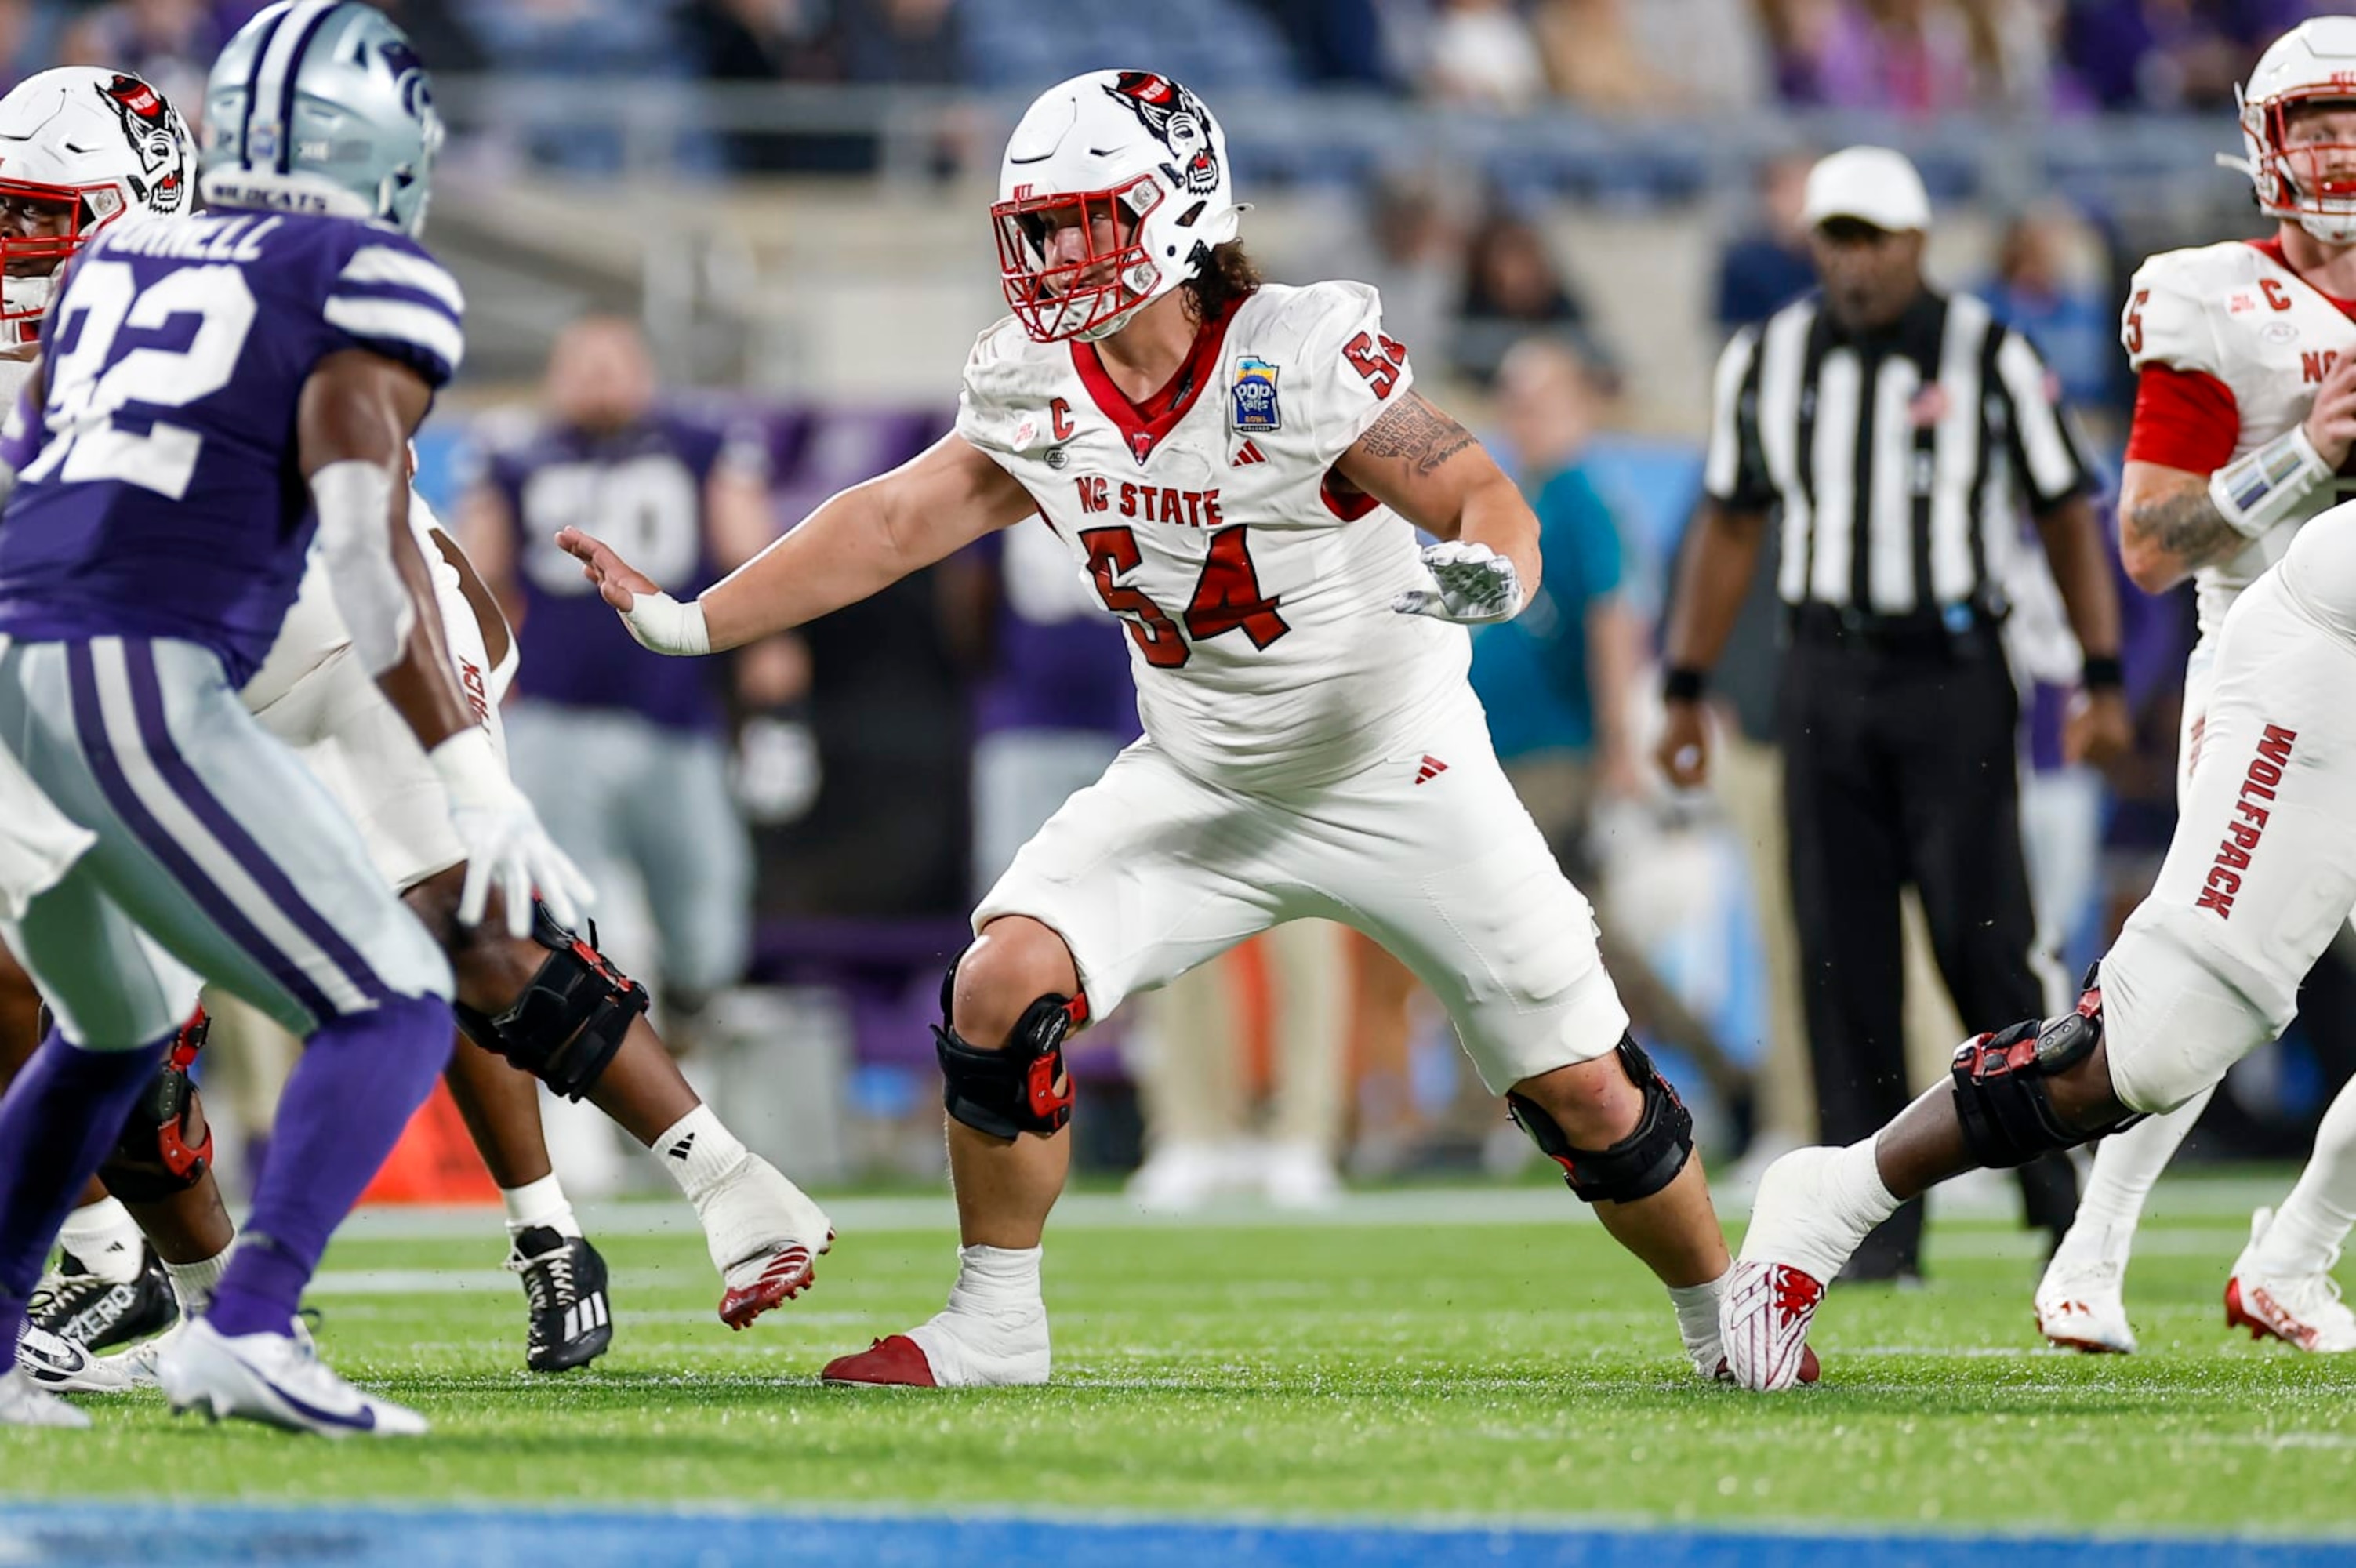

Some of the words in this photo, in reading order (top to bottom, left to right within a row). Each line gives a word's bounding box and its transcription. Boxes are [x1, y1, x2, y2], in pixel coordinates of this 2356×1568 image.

[2259, 279, 2292, 311] C
[1049, 397, 1074, 441] C
[1076, 477, 1109, 514] NC
[1120, 482, 1223, 528] STATE
[1078, 524, 1291, 669] 54
[2195, 723, 2298, 920] WOLFPACK
